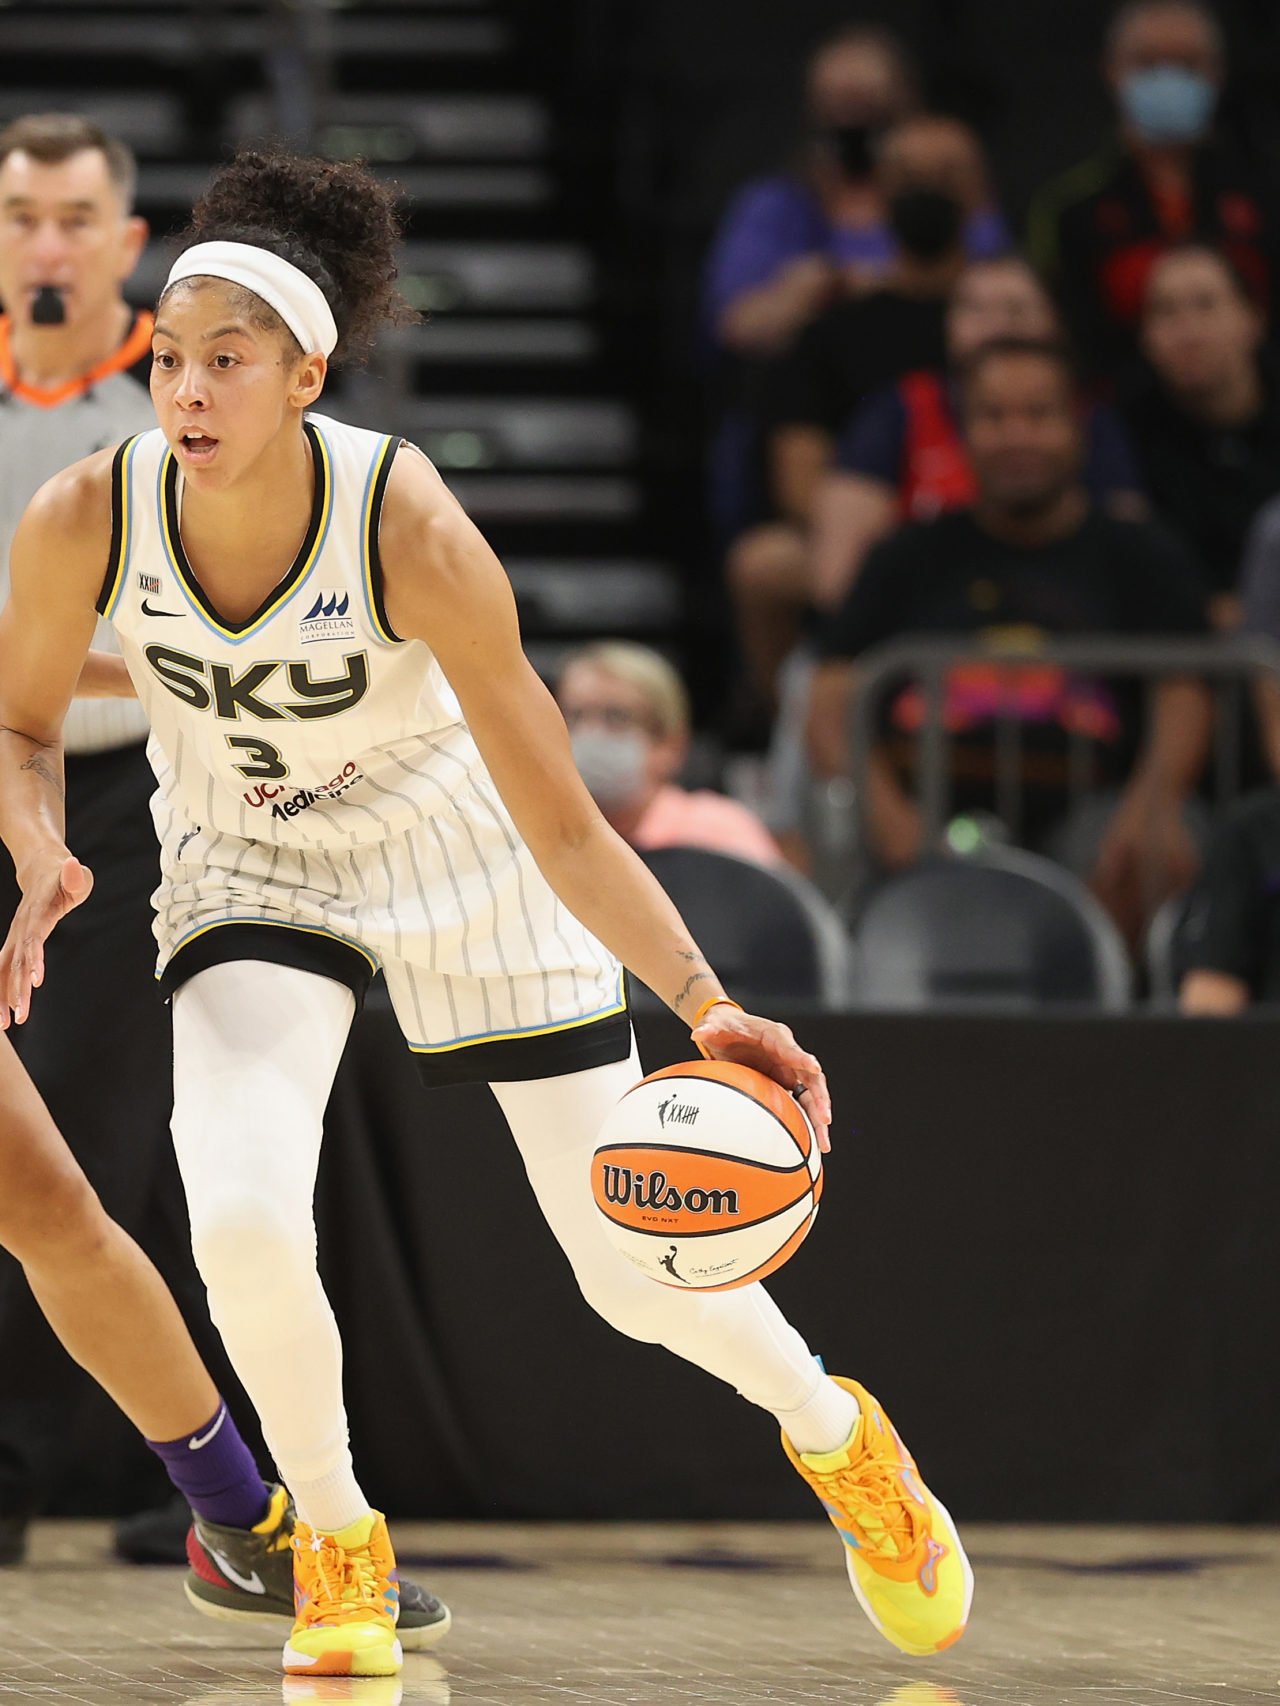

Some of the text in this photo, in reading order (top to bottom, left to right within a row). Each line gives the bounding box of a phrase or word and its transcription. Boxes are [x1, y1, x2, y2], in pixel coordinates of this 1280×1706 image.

[300, 621, 353, 632] MAGELLAN
[143, 642, 371, 722] SKY
[223, 734, 291, 781] 3
[602, 1163, 740, 1215] Wilson
